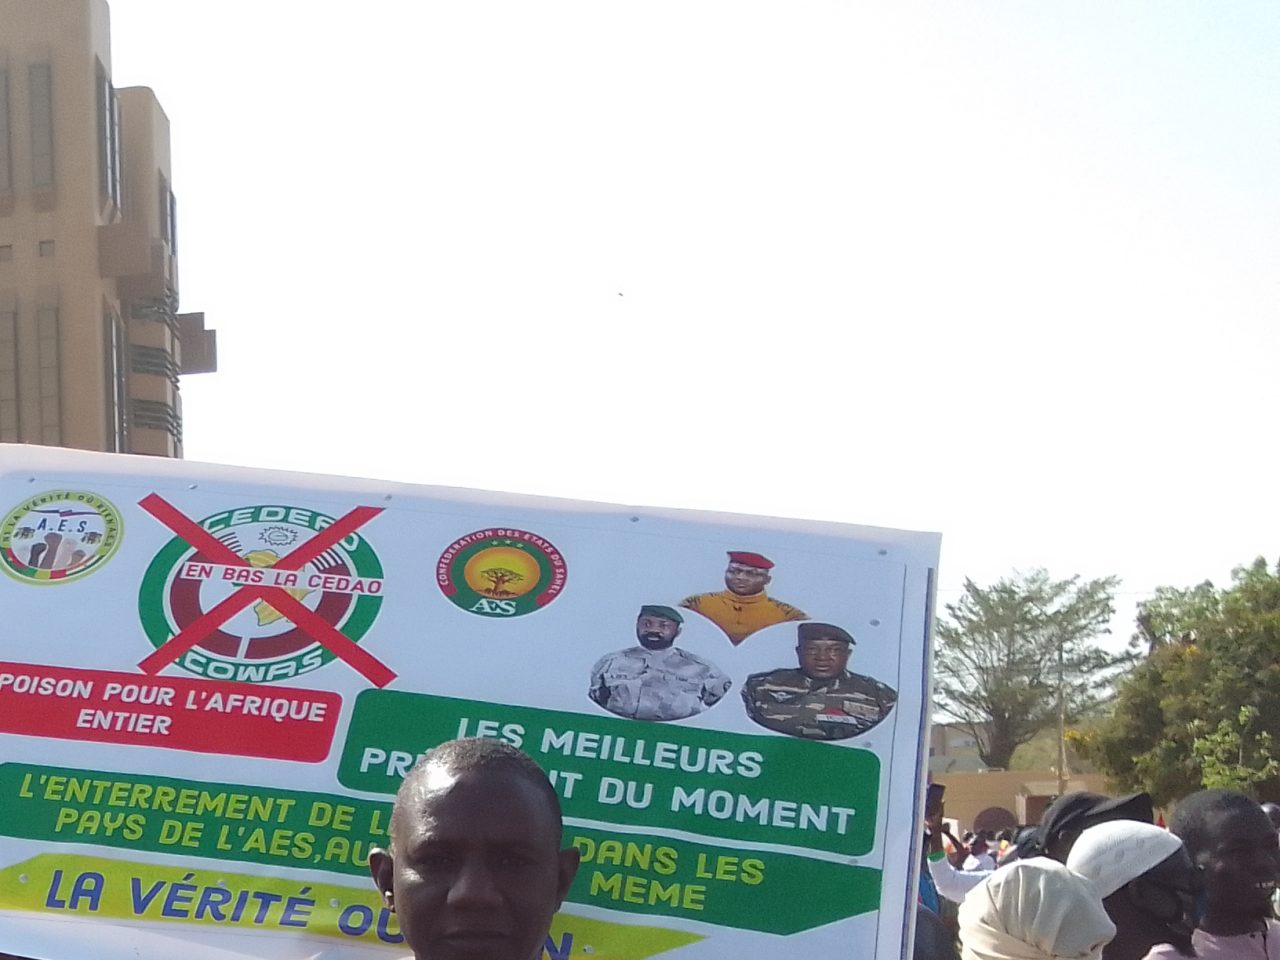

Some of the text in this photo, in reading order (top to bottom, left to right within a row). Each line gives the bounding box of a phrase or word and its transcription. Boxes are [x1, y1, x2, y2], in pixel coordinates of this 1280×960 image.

[185, 563, 382, 594] EN BAS LA CEDAO
[438, 529, 565, 595] CONFEDERATION DES ETATS DU SAHEL
[468, 598, 517, 615] AES
[174, 640, 324, 682] COWAS
[76, 708, 172, 736] ENTIER
[103, 682, 175, 707] POUR
[186, 690, 328, 722] L'AFRIQUE
[541, 728, 764, 779] MEILLEURS
[19, 772, 296, 823] L'ENTERREMENT
[308, 802, 355, 832] DE
[572, 837, 678, 876] DANS
[696, 852, 765, 886] LES
[598, 778, 652, 809] DU
[672, 787, 856, 835] MOMENT
[54, 807, 146, 840] PAYS
[158, 819, 203, 848] DE
[590, 872, 706, 912] MEME
[46, 869, 405, 945] LA VÉRITÉ OU
